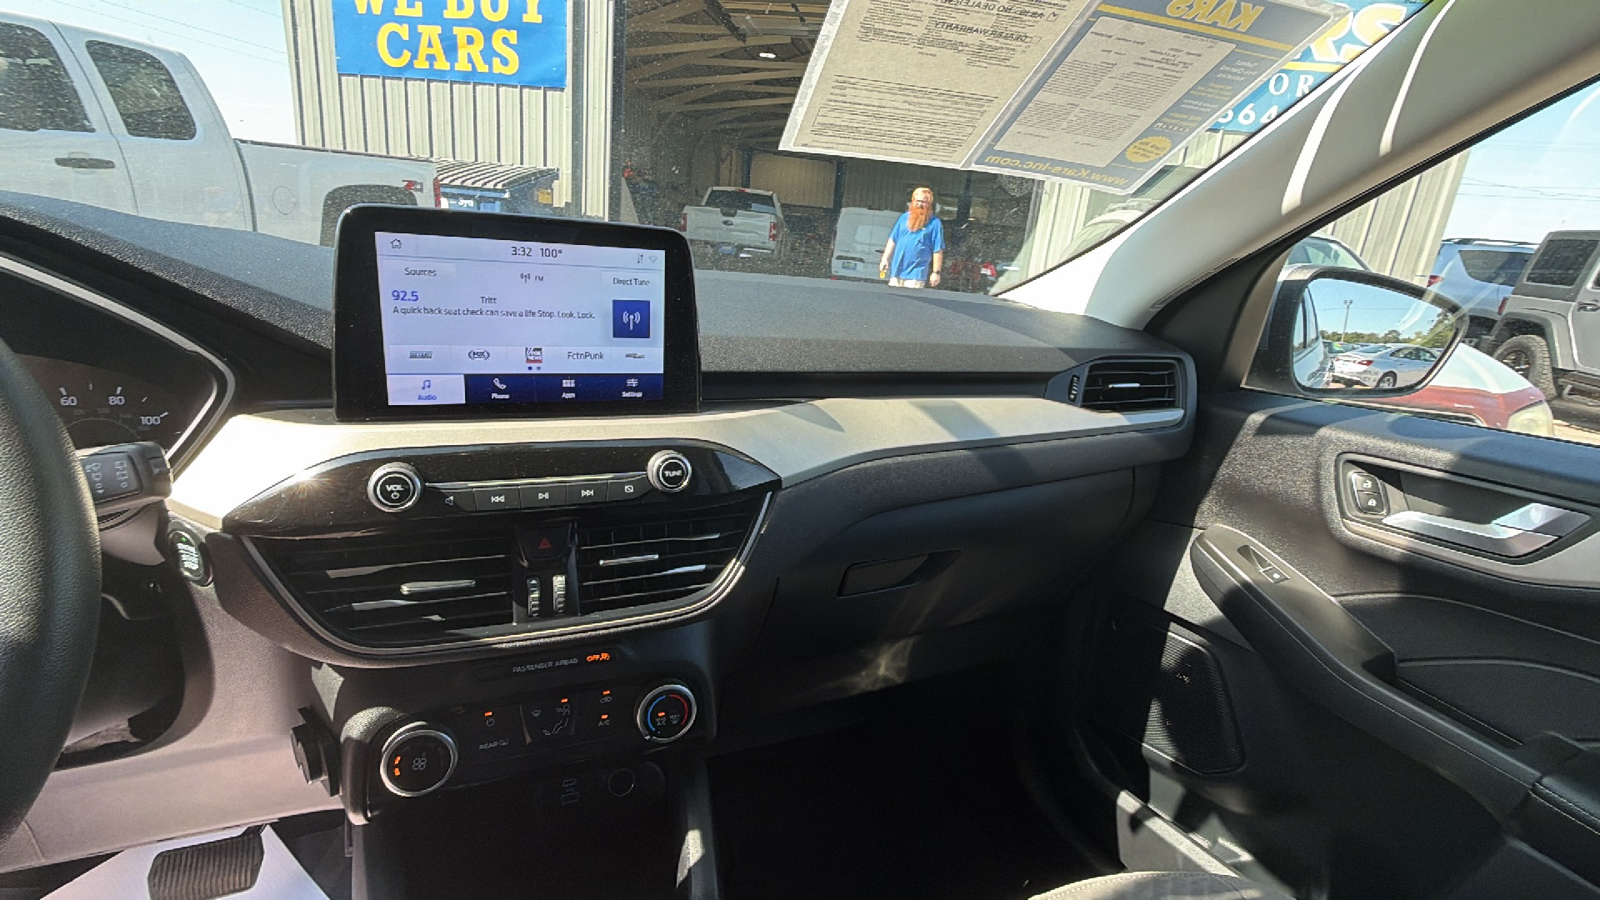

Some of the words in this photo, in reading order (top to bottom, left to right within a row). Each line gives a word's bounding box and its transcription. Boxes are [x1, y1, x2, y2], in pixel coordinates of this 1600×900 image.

[376, 22, 520, 75] CARS
[511, 246, 532, 257] 3:32
[404, 267, 437, 277] Sources
[613, 277, 632, 286] Direct
[634, 278, 650, 286] Tune
[391, 290, 419, 302] 92.5
[480, 296, 497, 304] Tritt
[393, 306, 399, 314] A
[401, 306, 422, 315] quick
[423, 307, 441, 315] back
[443, 308, 461, 316] seat
[462, 308, 484, 316] check
[567, 351, 605, 360] FctnPunk
[60, 396, 78, 406] 60
[108, 396, 125, 405] 80
[140, 416, 161, 425] 100
[664, 469, 682, 477] TUNE
[512, 661, 553, 672] PASSENGER
[554, 658, 579, 667] AIRBAG
[479, 741, 498, 750] REAR
